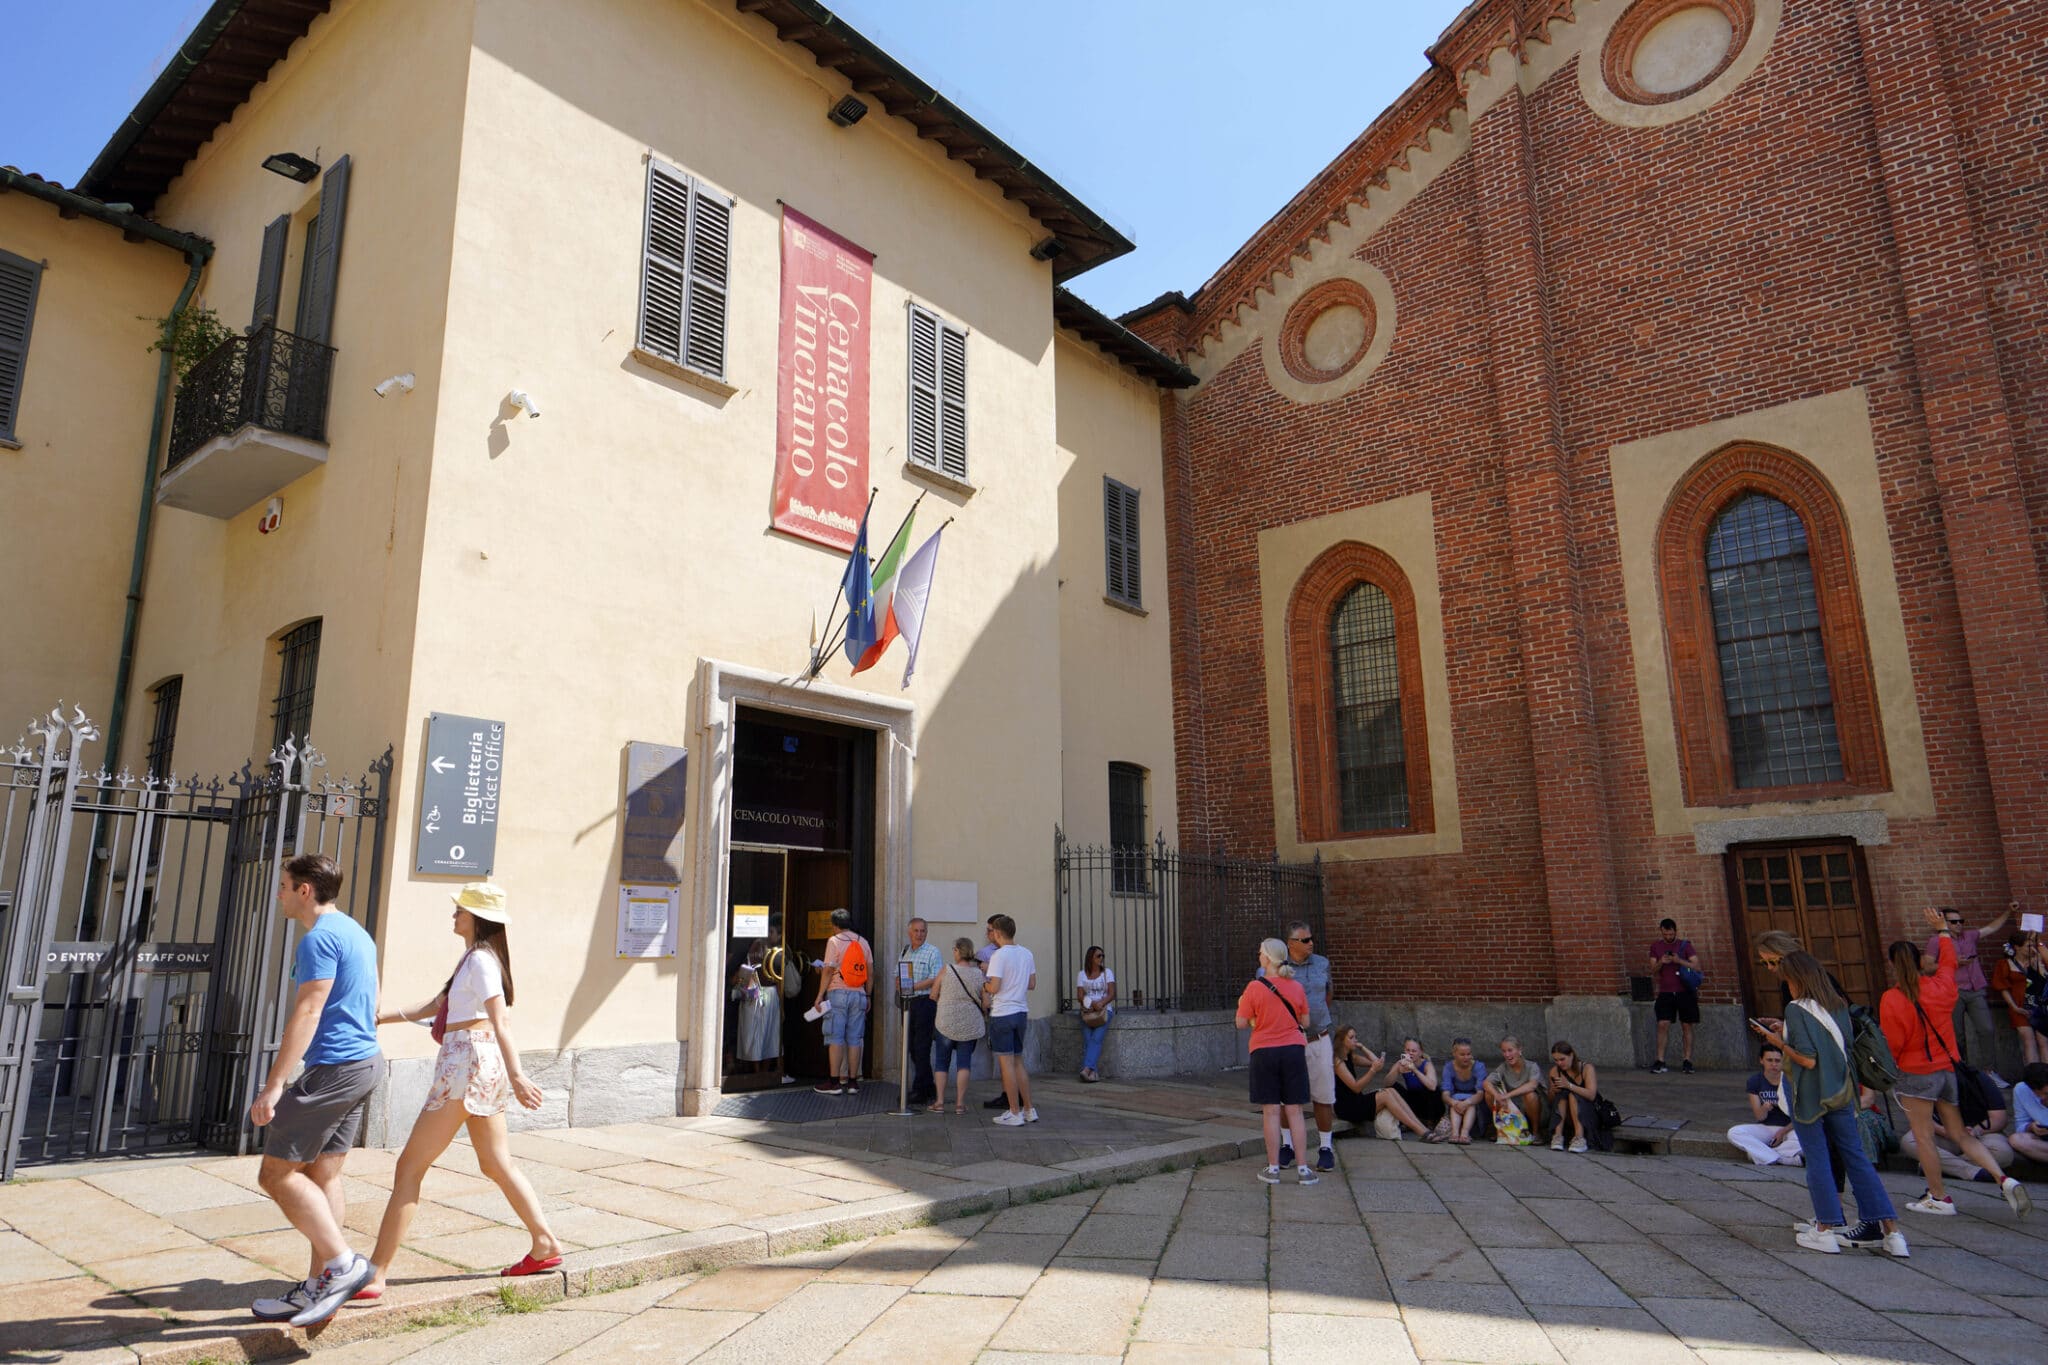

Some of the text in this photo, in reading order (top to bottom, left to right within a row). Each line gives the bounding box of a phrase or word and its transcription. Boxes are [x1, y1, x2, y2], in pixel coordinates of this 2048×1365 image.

[791, 284, 829, 477] Vinciano
[825, 292, 860, 490] Cenacolo
[334, 796, 347, 816] 2
[462, 732, 483, 824] Biglietteria
[481, 724, 502, 825] Ticket Office
[734, 809, 790, 825] CENACOLO
[47, 952, 210, 962] O ENTRY STAFF ONLY
